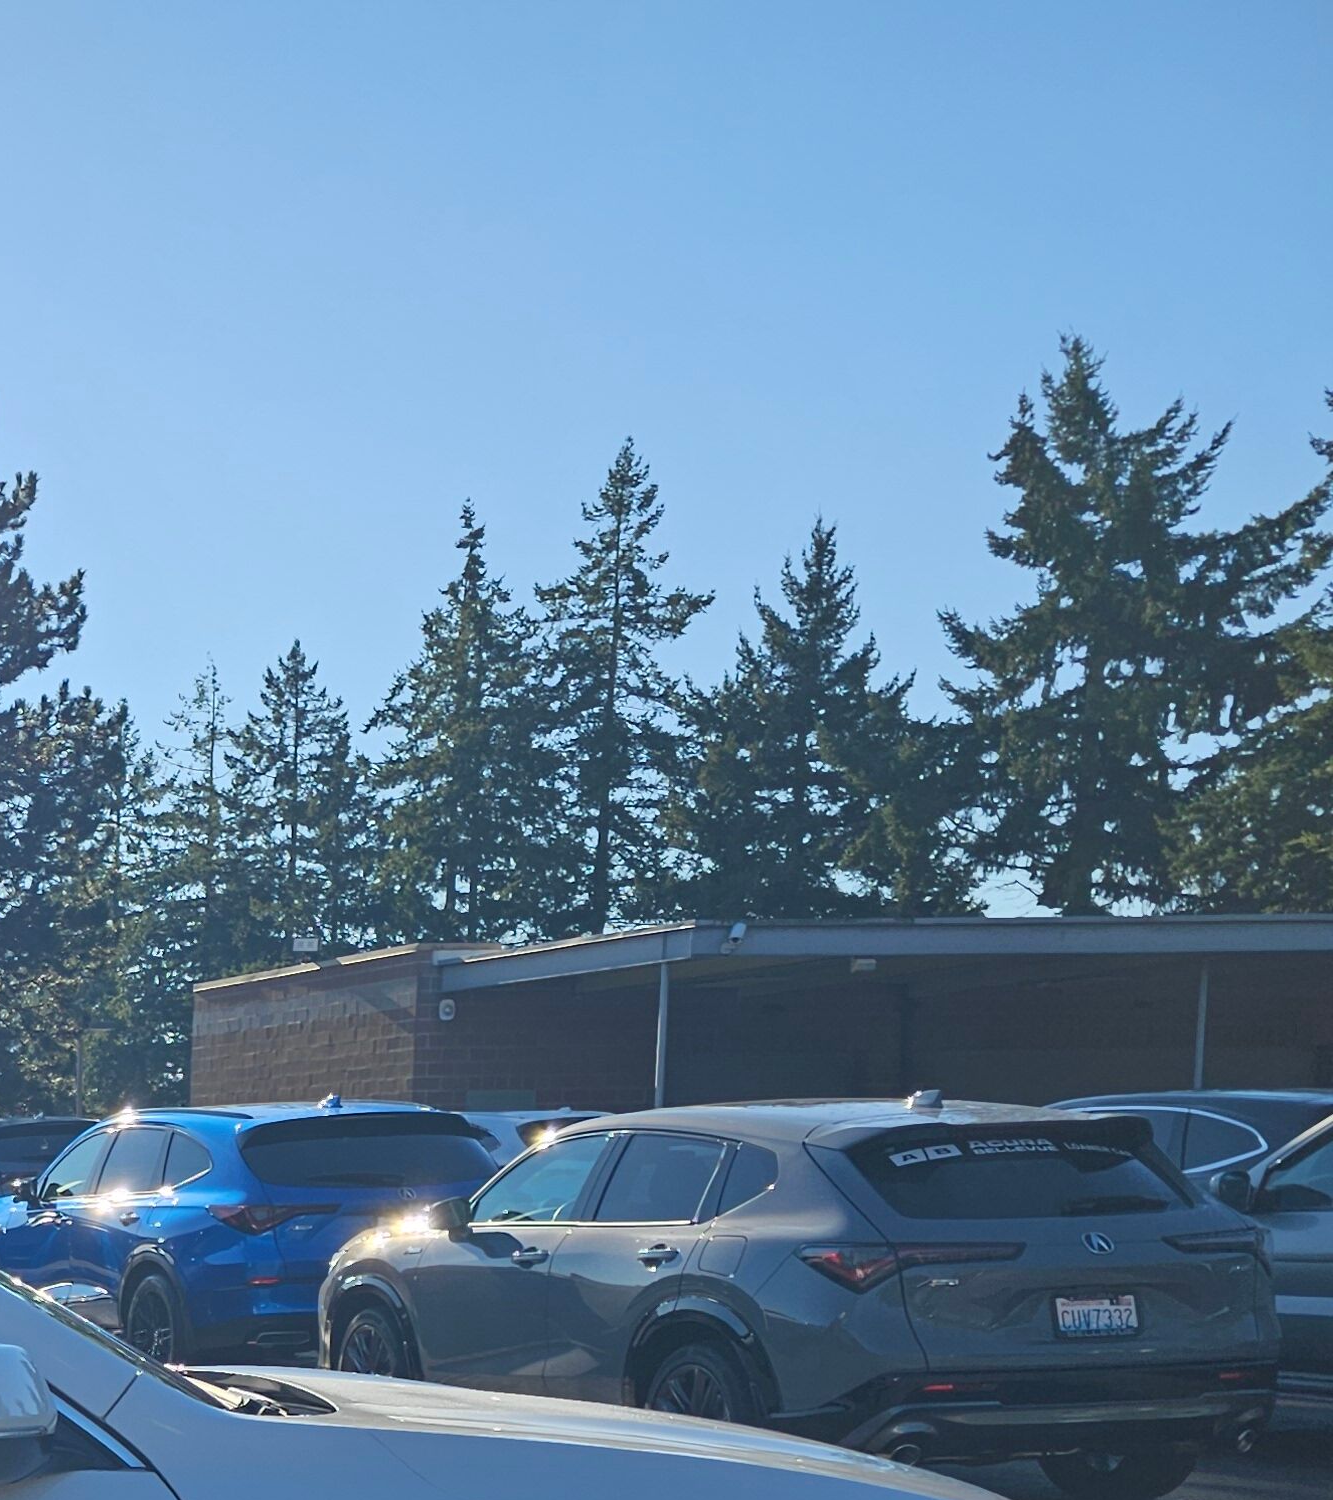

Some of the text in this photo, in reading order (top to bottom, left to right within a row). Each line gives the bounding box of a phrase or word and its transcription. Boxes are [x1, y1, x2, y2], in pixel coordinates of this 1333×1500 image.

[968, 1138, 1054, 1149] ACURA
[973, 1145, 1059, 1155] BELLEVUE
[1061, 1308, 1137, 1330] CUV7332
